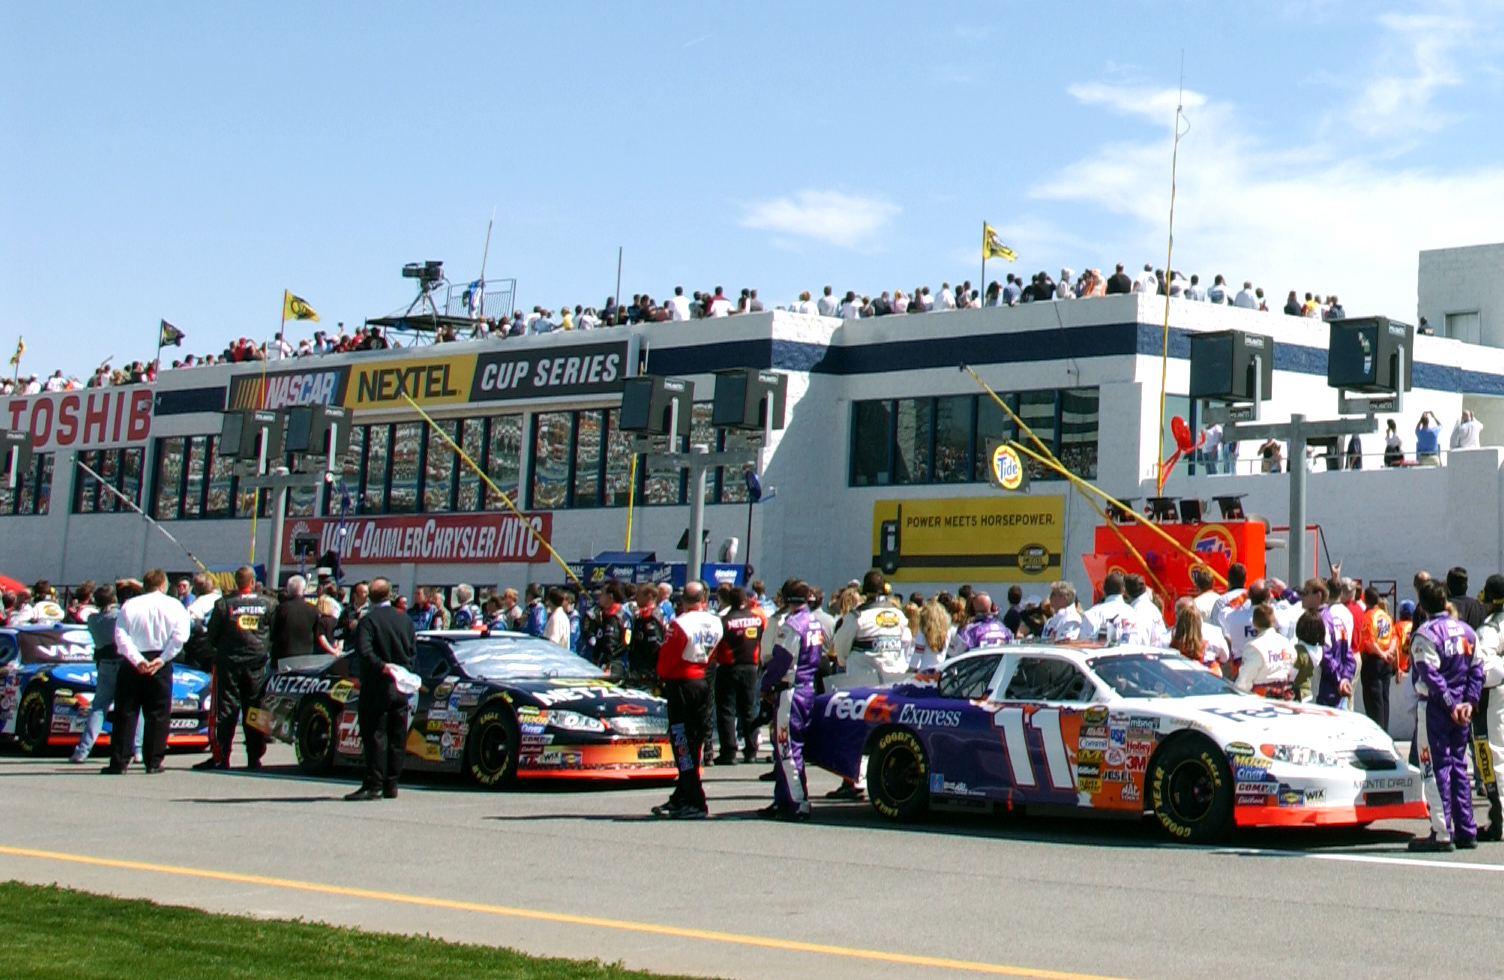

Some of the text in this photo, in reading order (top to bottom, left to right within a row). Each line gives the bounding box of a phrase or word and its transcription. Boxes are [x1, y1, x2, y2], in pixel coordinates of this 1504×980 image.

[357, 364, 458, 402] NEXTEL
[481, 353, 619, 392] CUP SERIES
[265, 371, 334, 409] NASCAR
[998, 456, 1018, 480] Tide
[907, 513, 1055, 528] POWER MEETS HORSEPOWER.
[728, 617, 761, 628] NETZERO
[1268, 648, 1292, 662] FedEx
[824, 692, 898, 722] FedEx
[899, 703, 962, 729] Express
[992, 707, 1079, 793] 11
[1125, 756, 1146, 770] 3M
[1306, 790, 1324, 801] WIX
[1353, 779, 1385, 789] MONTE
